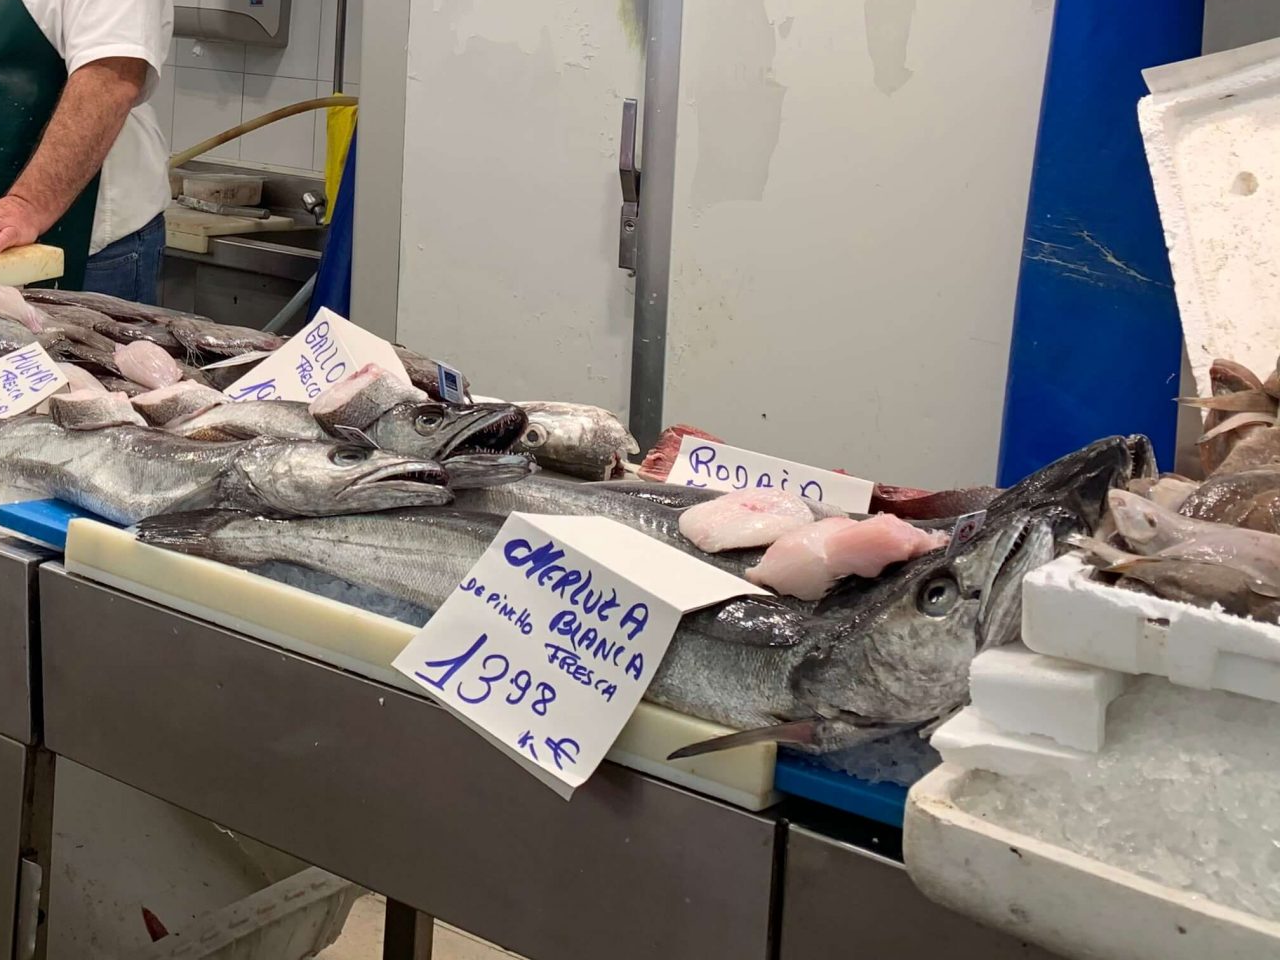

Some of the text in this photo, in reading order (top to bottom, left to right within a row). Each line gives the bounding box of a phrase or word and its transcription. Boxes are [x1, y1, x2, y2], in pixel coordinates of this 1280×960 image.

[304, 321, 346, 384] GALLO
[503, 538, 650, 641] MERLUZA
[544, 642, 618, 703] FRESCA
[549, 609, 644, 681] BLANCA
